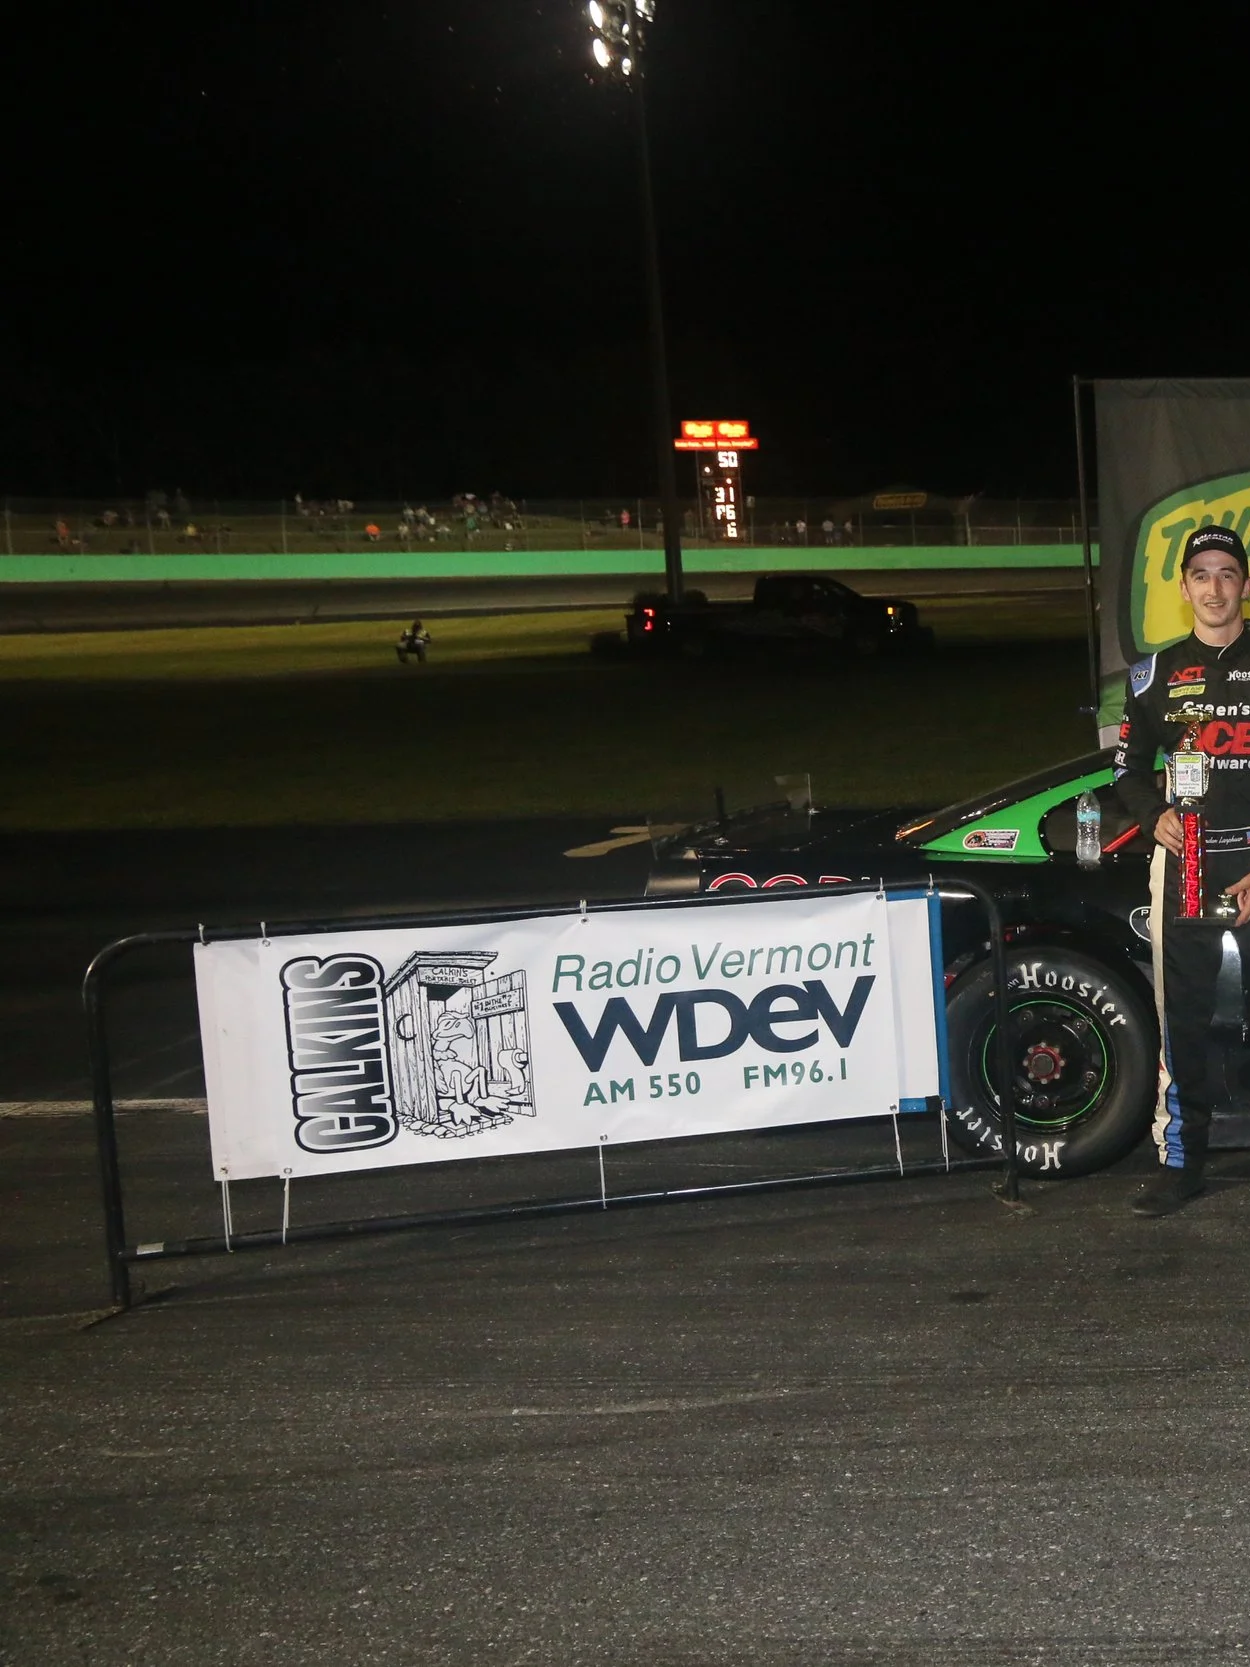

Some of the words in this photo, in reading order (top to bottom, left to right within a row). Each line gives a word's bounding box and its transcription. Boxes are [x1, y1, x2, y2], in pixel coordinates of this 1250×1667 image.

[1169, 666, 1205, 683] ACT
[432, 967, 468, 977] CALKIN'S
[552, 947, 682, 993] Radio
[692, 932, 875, 980] Vermont
[1017, 962, 1127, 1026] Hoosier
[280, 953, 399, 1154] CALKINS
[583, 1077, 635, 1106] AM
[650, 1071, 702, 1099] 550
[743, 1058, 847, 1089] FM96.1
[956, 1106, 1066, 1171] Hosier
